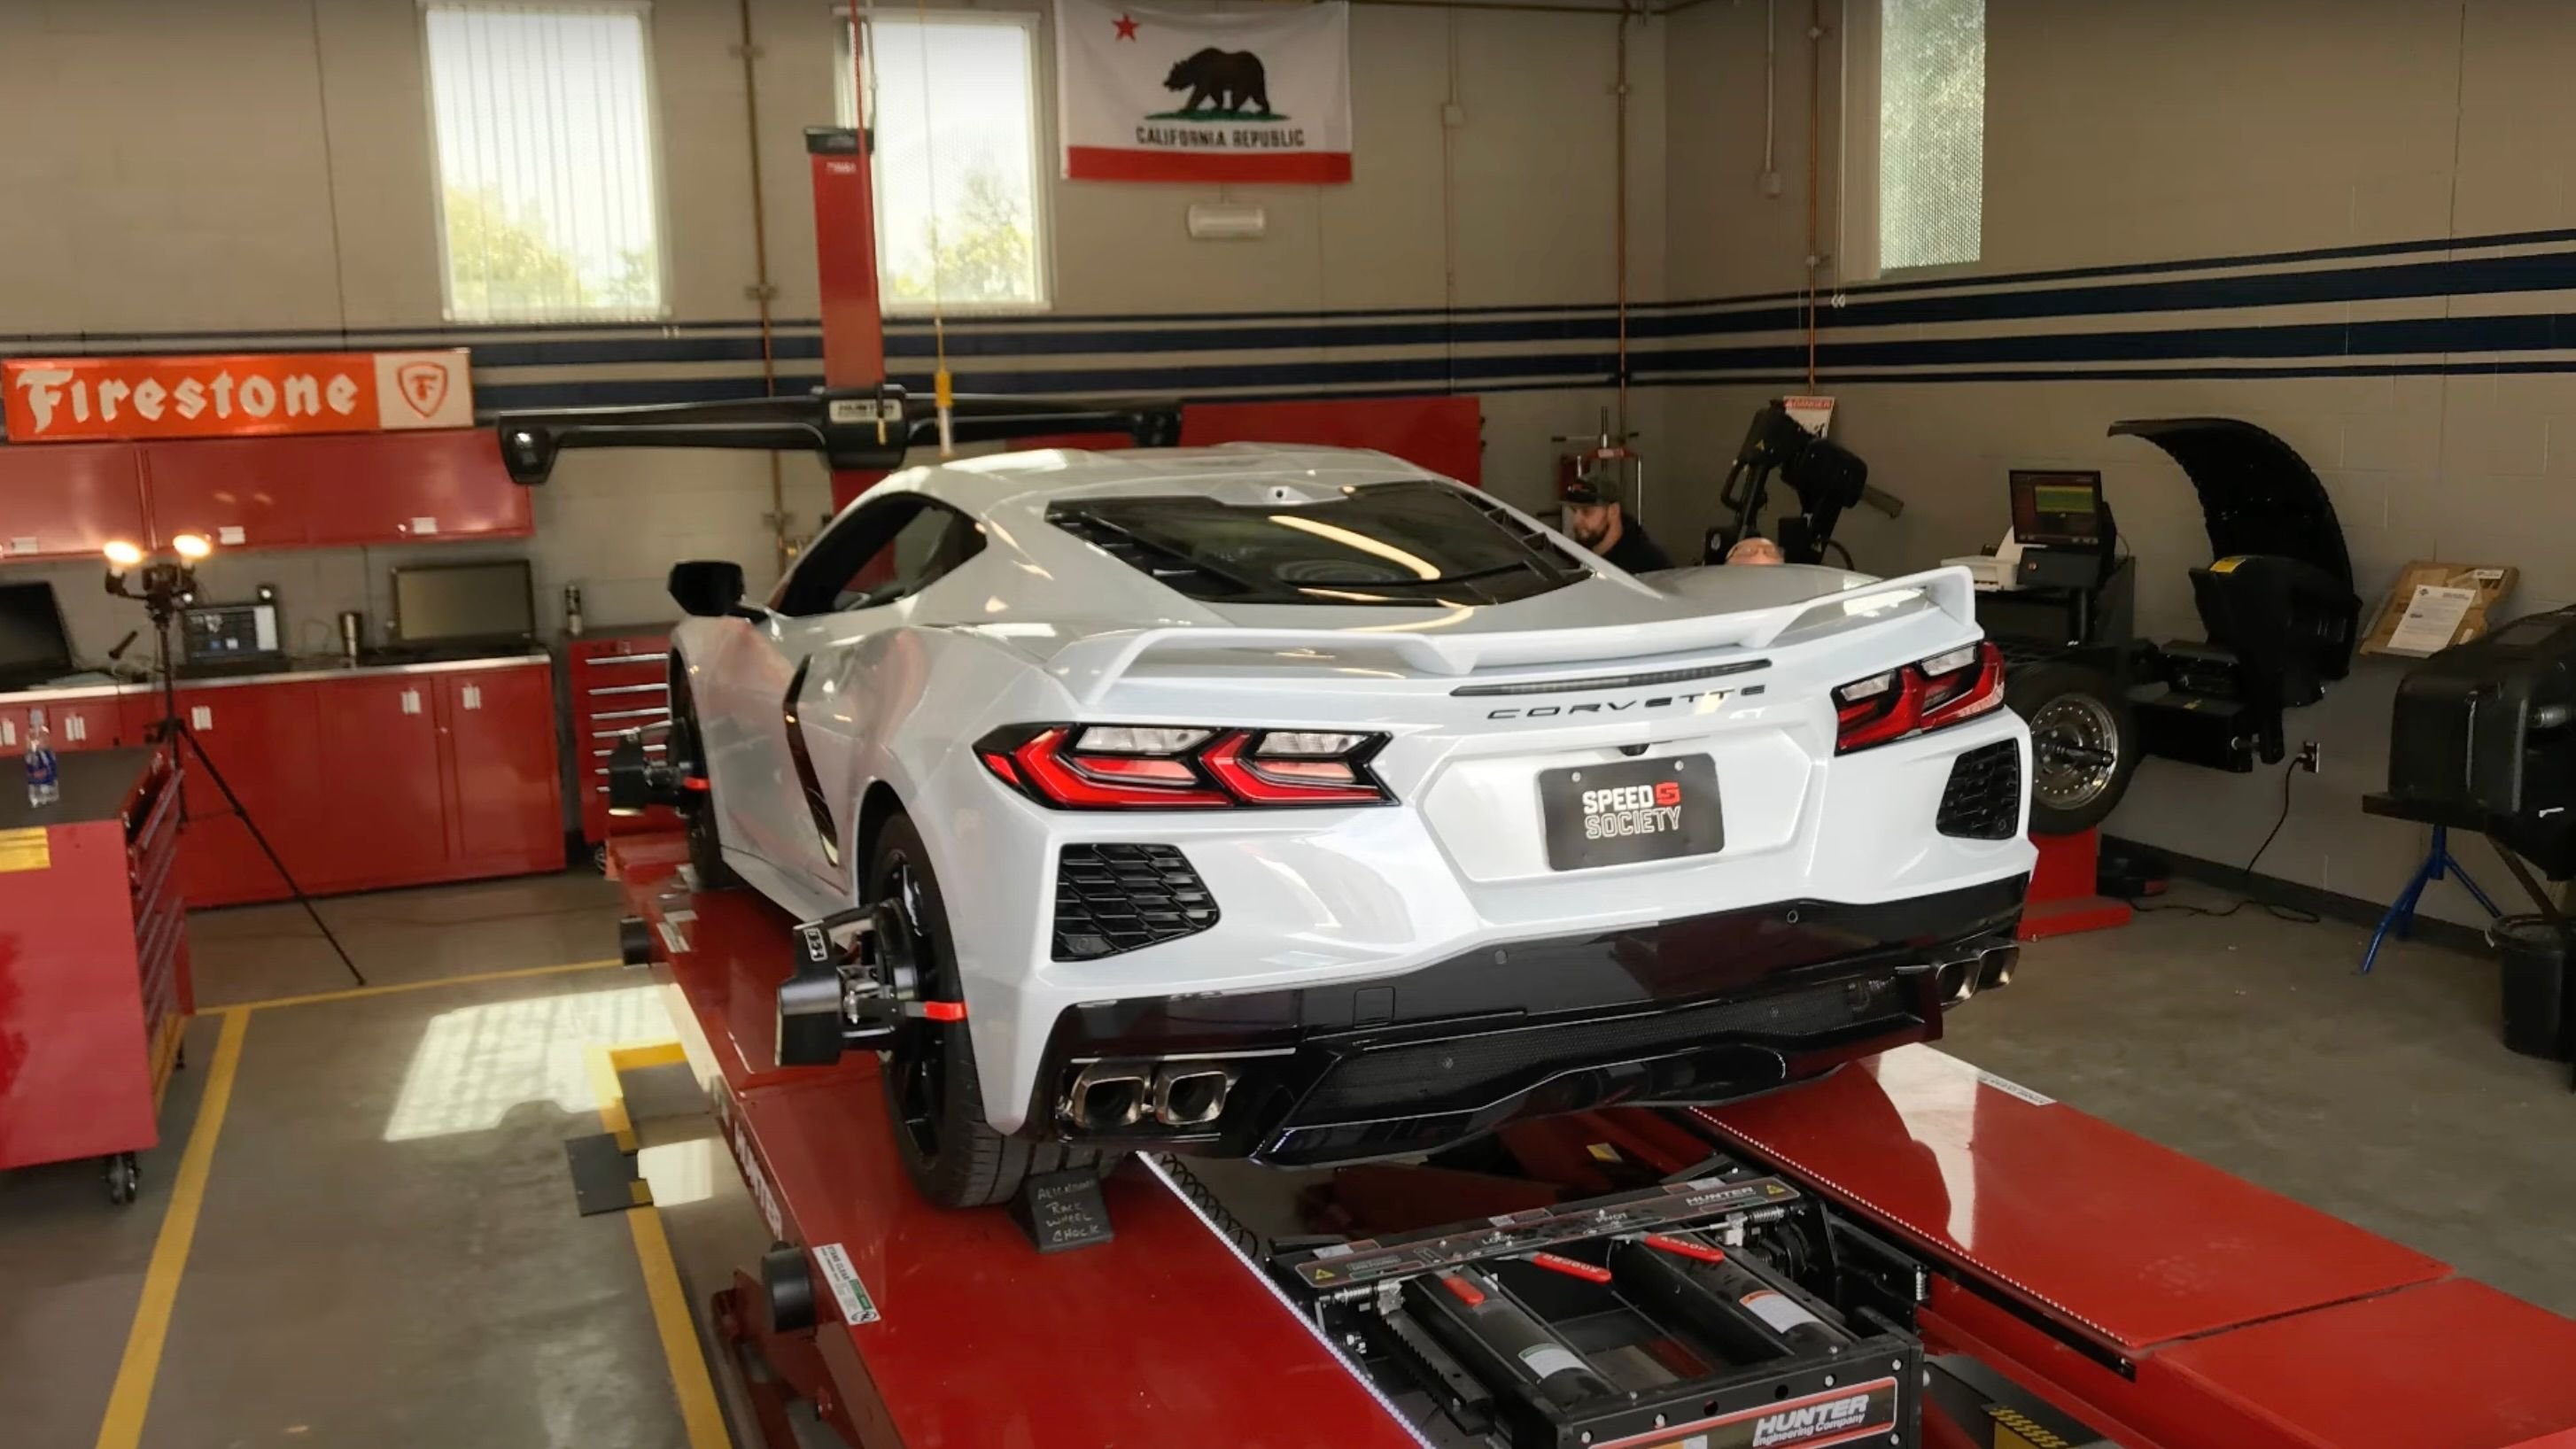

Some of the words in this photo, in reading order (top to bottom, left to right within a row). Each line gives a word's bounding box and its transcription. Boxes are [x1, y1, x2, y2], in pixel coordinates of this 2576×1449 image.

[1136, 127, 1227, 147] CALIFORNIA
[1232, 128, 1305, 148] REPUBLIC
[16, 368, 359, 434] Firestone
[1487, 684, 1766, 720] CORVETTE
[1582, 784, 1655, 815] SPEED
[1584, 805, 1682, 841] SOCIETY
[1686, 1187, 1757, 1205] HUNTER
[1753, 1424, 1814, 1447] Engineering
[1816, 1414, 1866, 1431] Company
[1756, 1394, 1869, 1434] HUNTER
